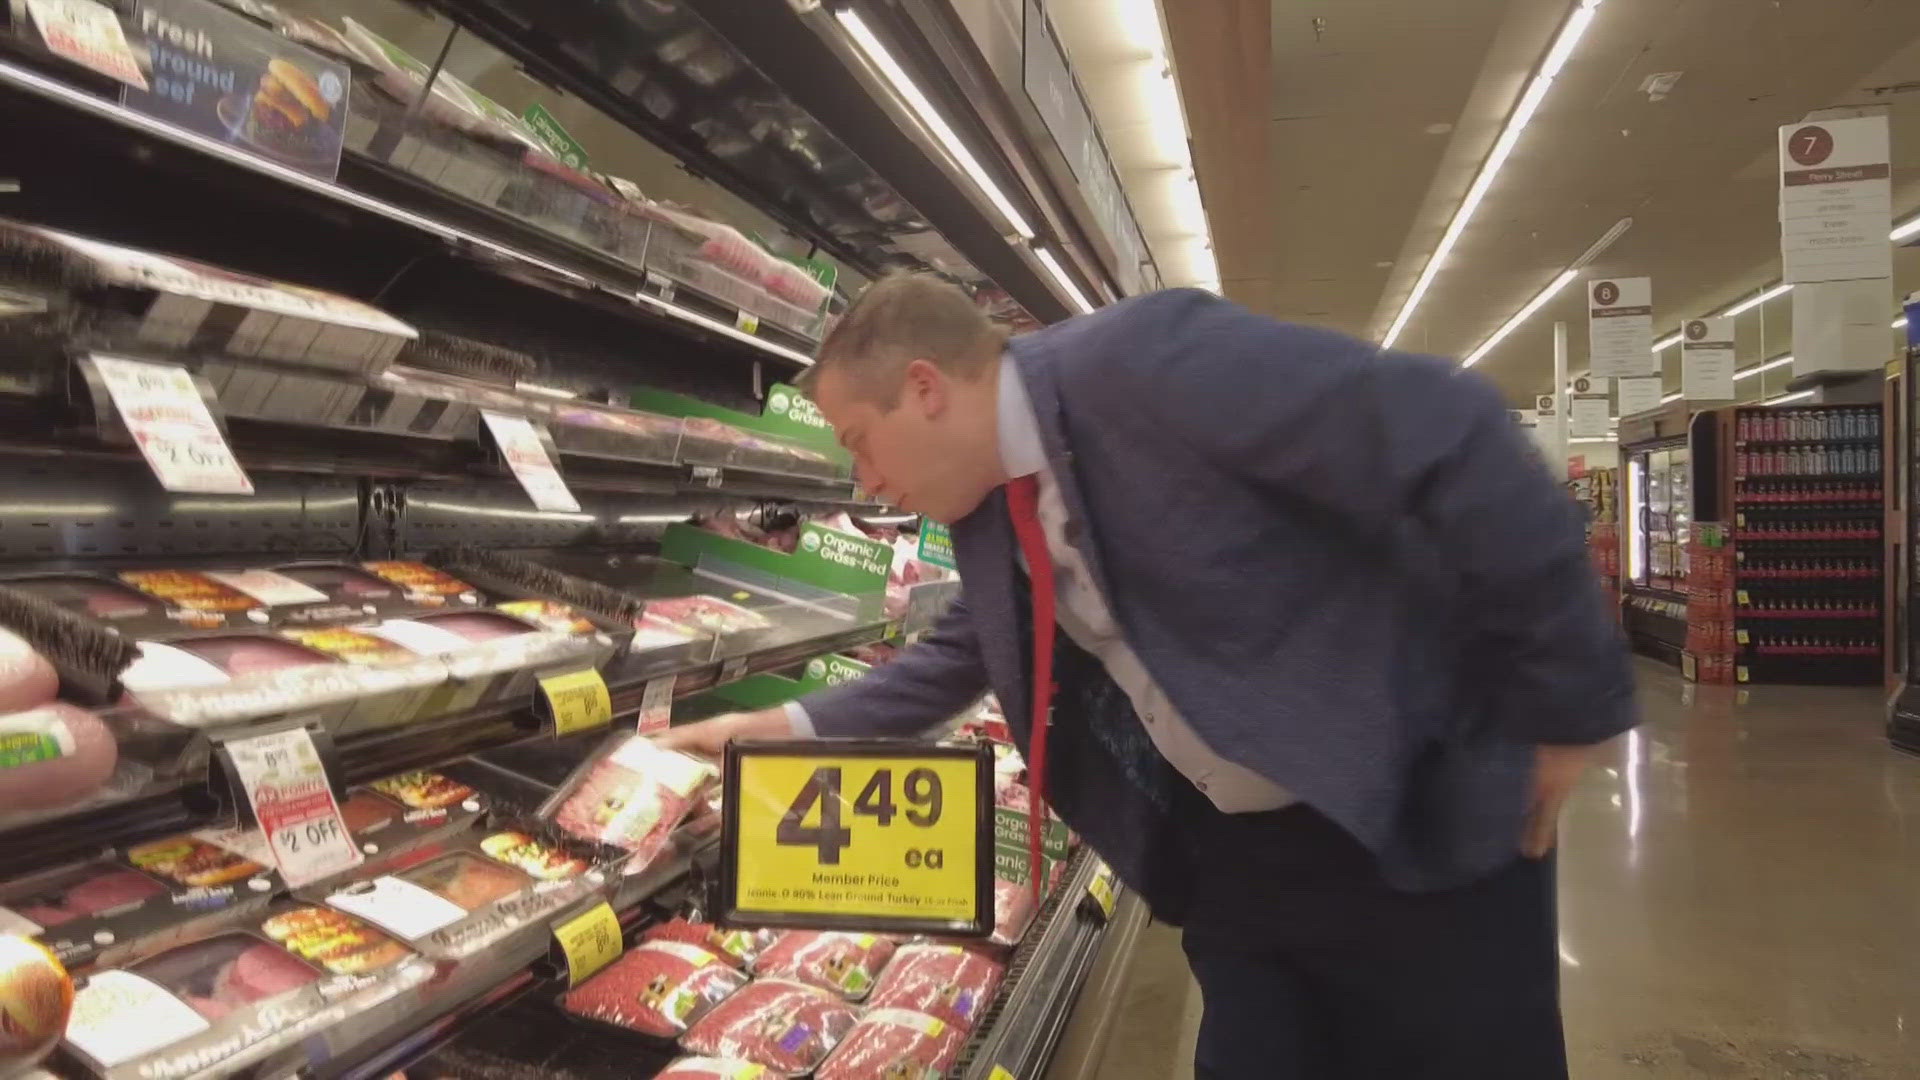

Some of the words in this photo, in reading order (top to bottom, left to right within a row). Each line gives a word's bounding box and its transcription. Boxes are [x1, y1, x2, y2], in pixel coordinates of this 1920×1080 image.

[155, 76, 195, 105] eef
[1804, 136, 1817, 155] 7
[1601, 287, 1612, 300] 8
[820, 546, 887, 576] Grass-Fed
[306, 818, 338, 846] OFF
[904, 848, 943, 869] ea
[812, 872, 865, 887] Member
[868, 874, 899, 888] Price
[888, 893, 921, 906] Turkey
